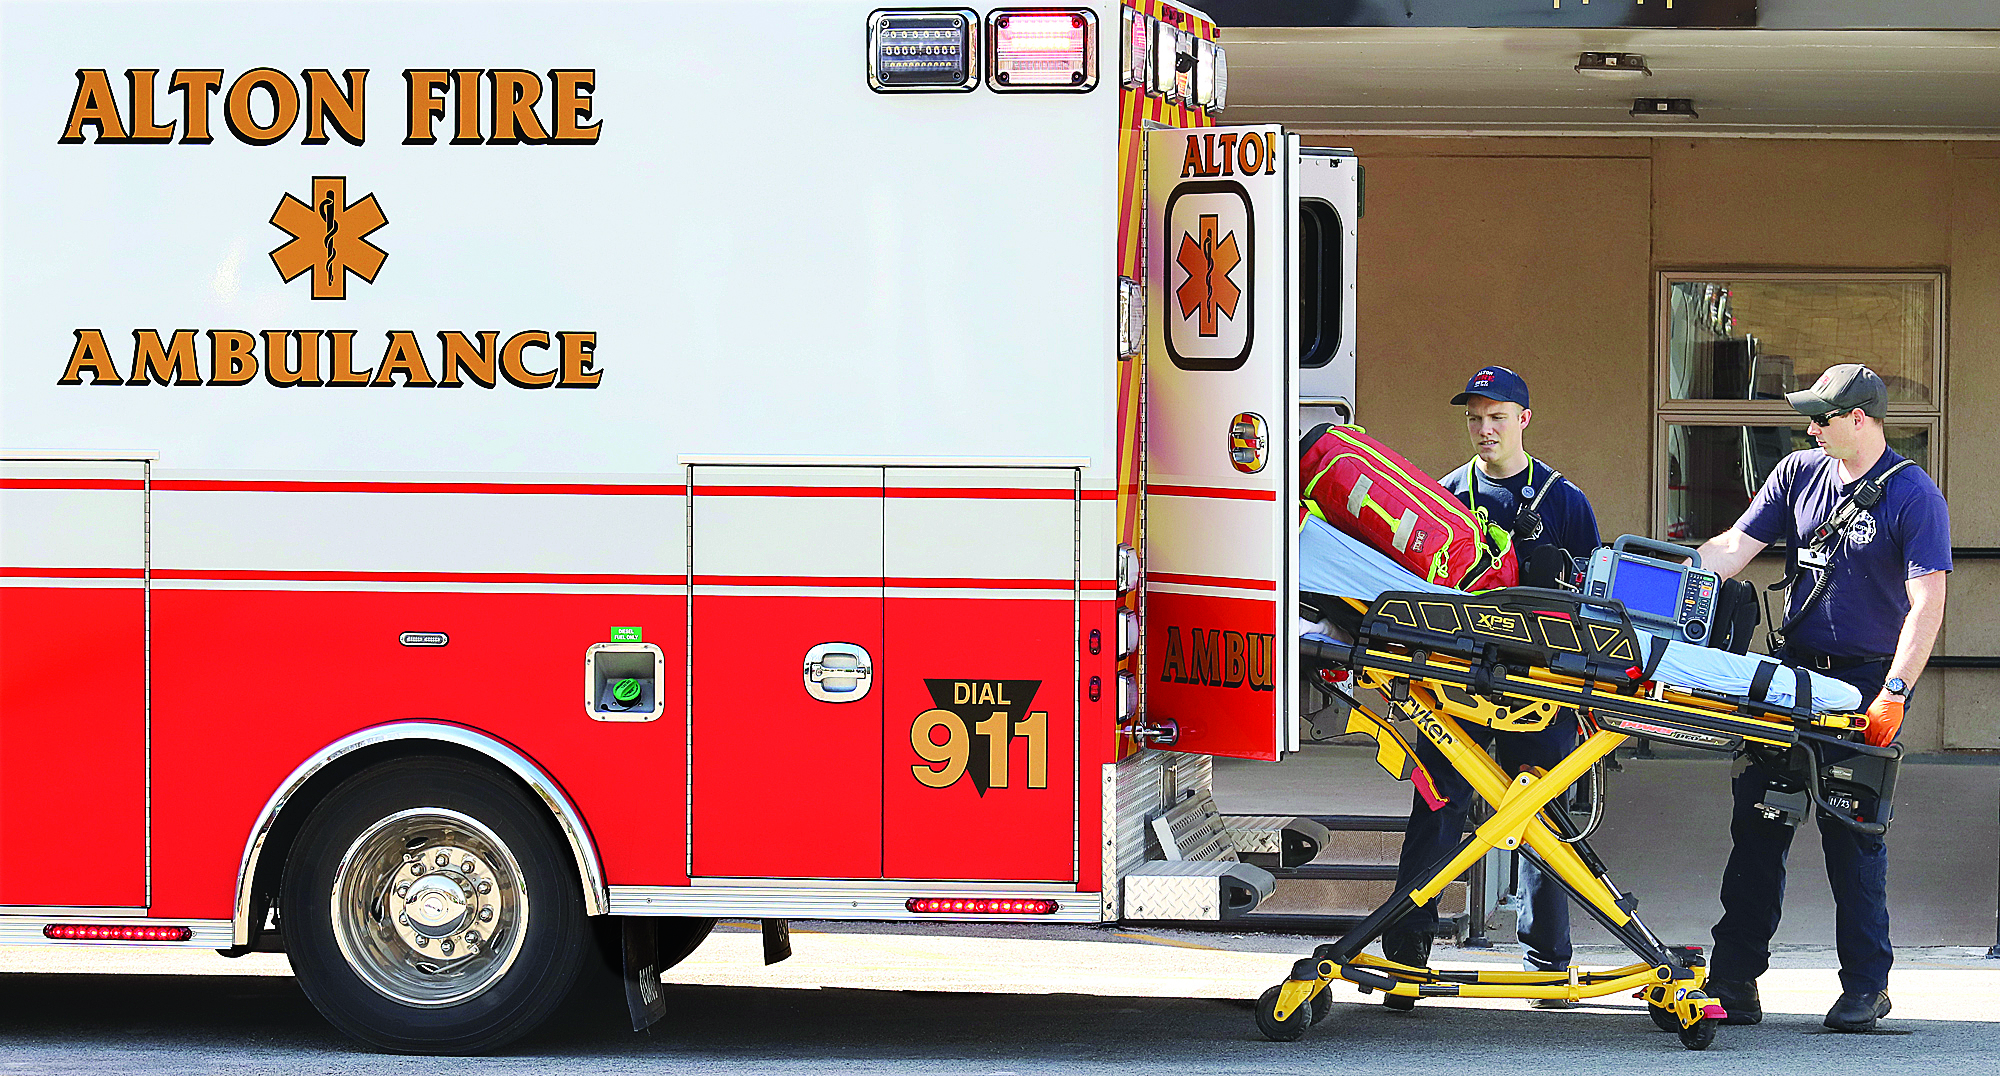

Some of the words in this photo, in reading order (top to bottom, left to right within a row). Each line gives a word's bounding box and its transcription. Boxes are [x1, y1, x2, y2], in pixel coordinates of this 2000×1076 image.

[57, 67, 369, 146] ALTON
[401, 68, 604, 146] FIRE
[57, 328, 604, 389] AMBULANCE
[1477, 612, 1516, 630] XPS
[1160, 626, 1275, 691] AMBU
[953, 681, 1012, 706] DIAL
[1400, 695, 1453, 745] ryker
[909, 707, 1048, 790] 911
[1829, 797, 1851, 809] 11/23
